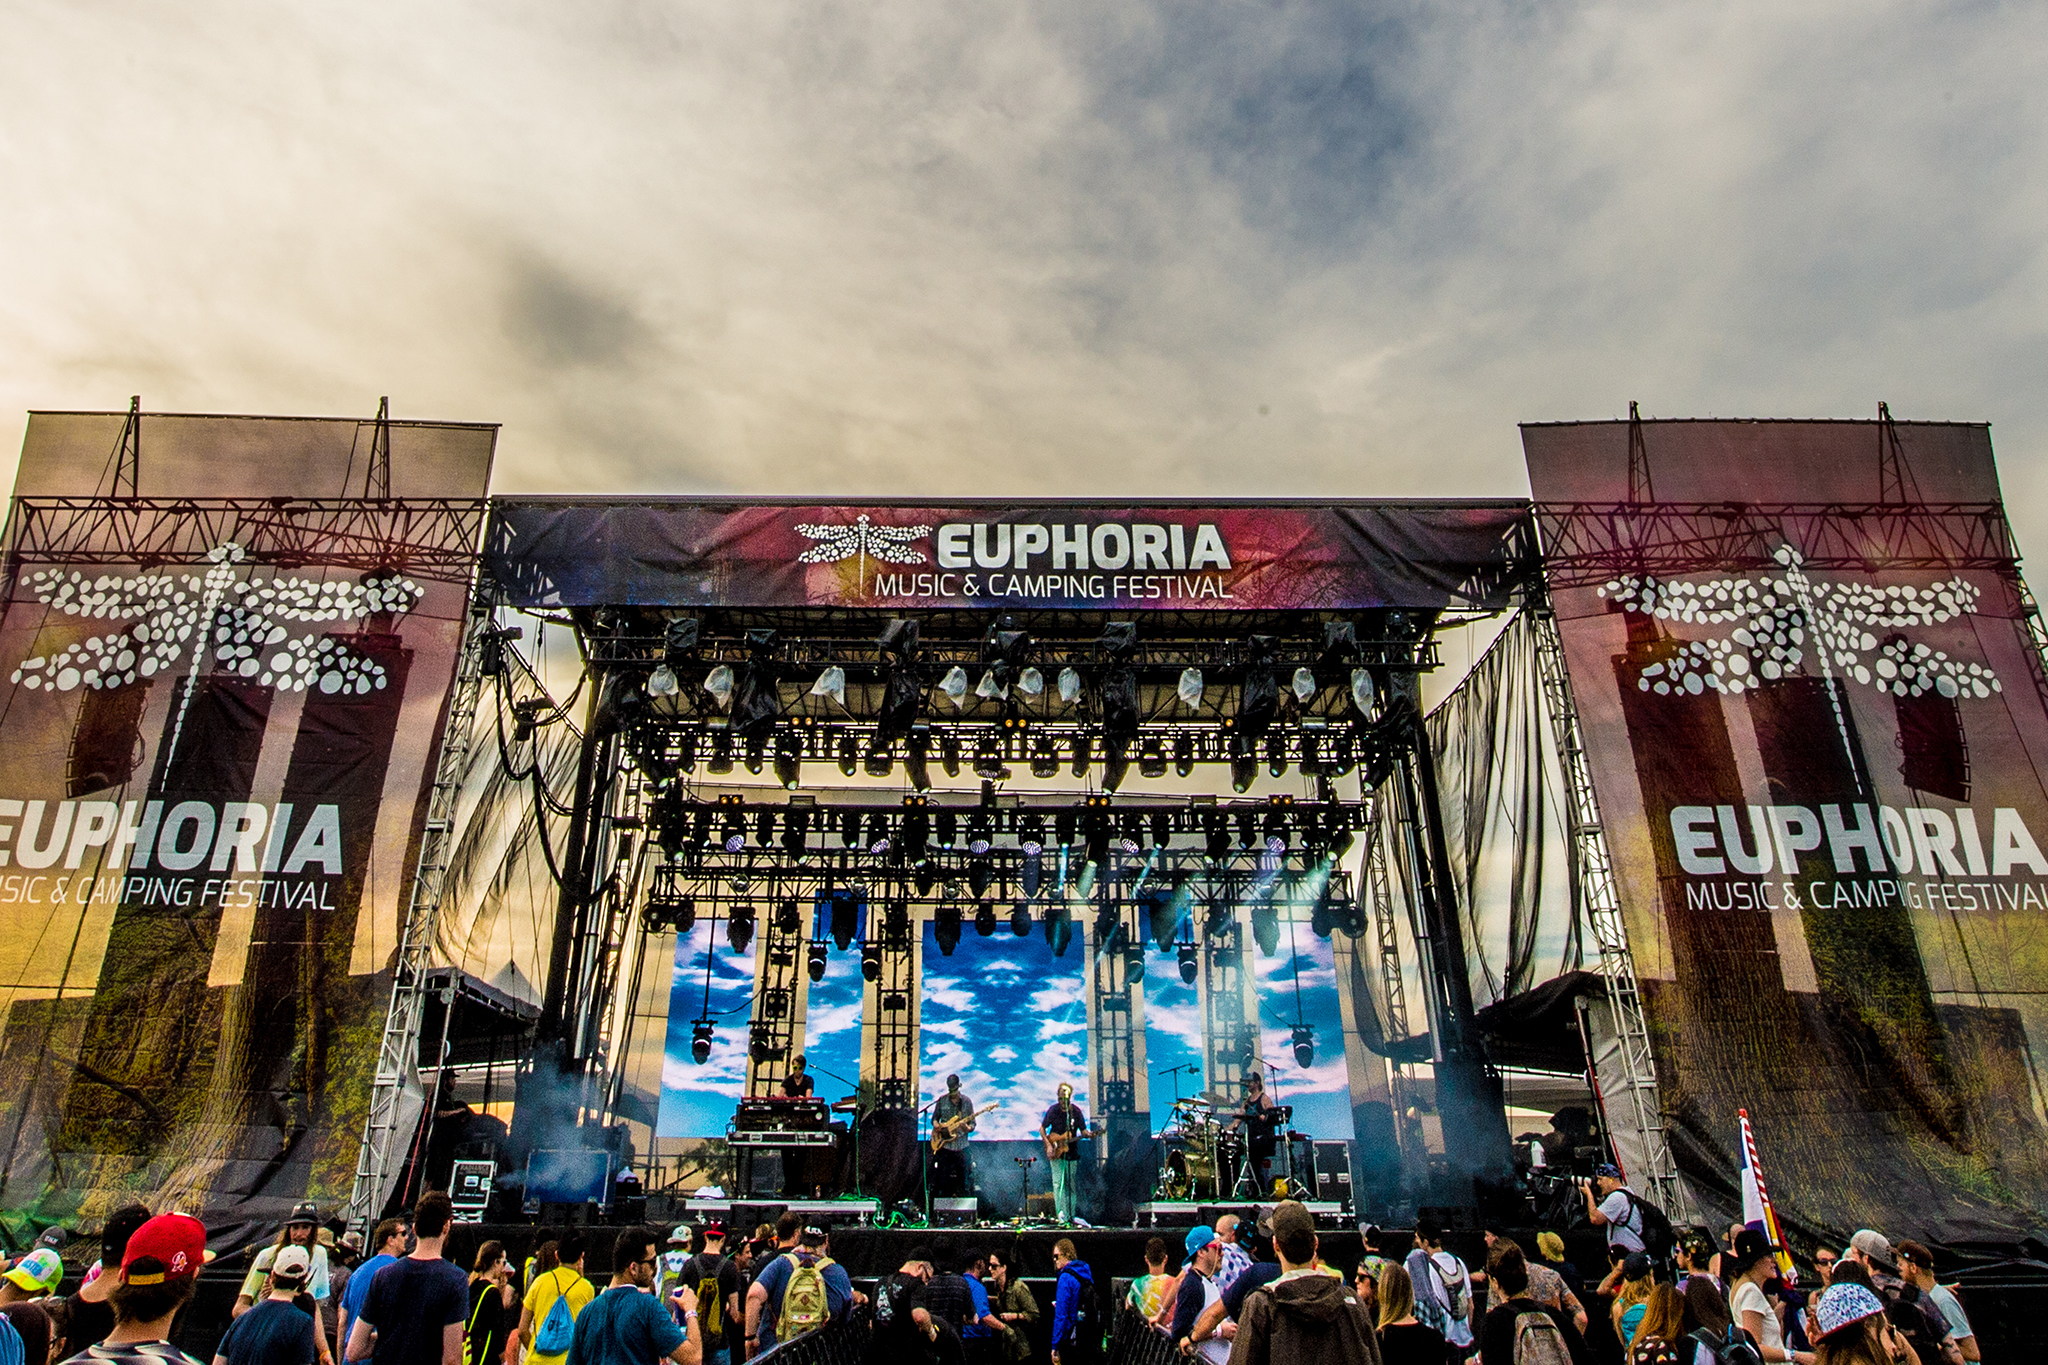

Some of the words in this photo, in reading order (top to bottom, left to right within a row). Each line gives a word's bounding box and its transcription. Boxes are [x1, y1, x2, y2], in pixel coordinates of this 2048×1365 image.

[938, 523, 1232, 570] EUPHORIA
[875, 573, 956, 597] MUSIC
[963, 573, 981, 597] &
[988, 573, 1105, 598] CAMPING
[1113, 575, 1234, 599] FESTIVAL
[1670, 803, 2048, 876] EUPHORIA
[0, 875, 47, 904] SIC
[50, 876, 69, 905] &
[76, 876, 195, 906] CAMPING
[200, 879, 335, 911] FESTIVAL
[1685, 881, 1779, 911] MUSIC
[1783, 882, 1804, 911] &
